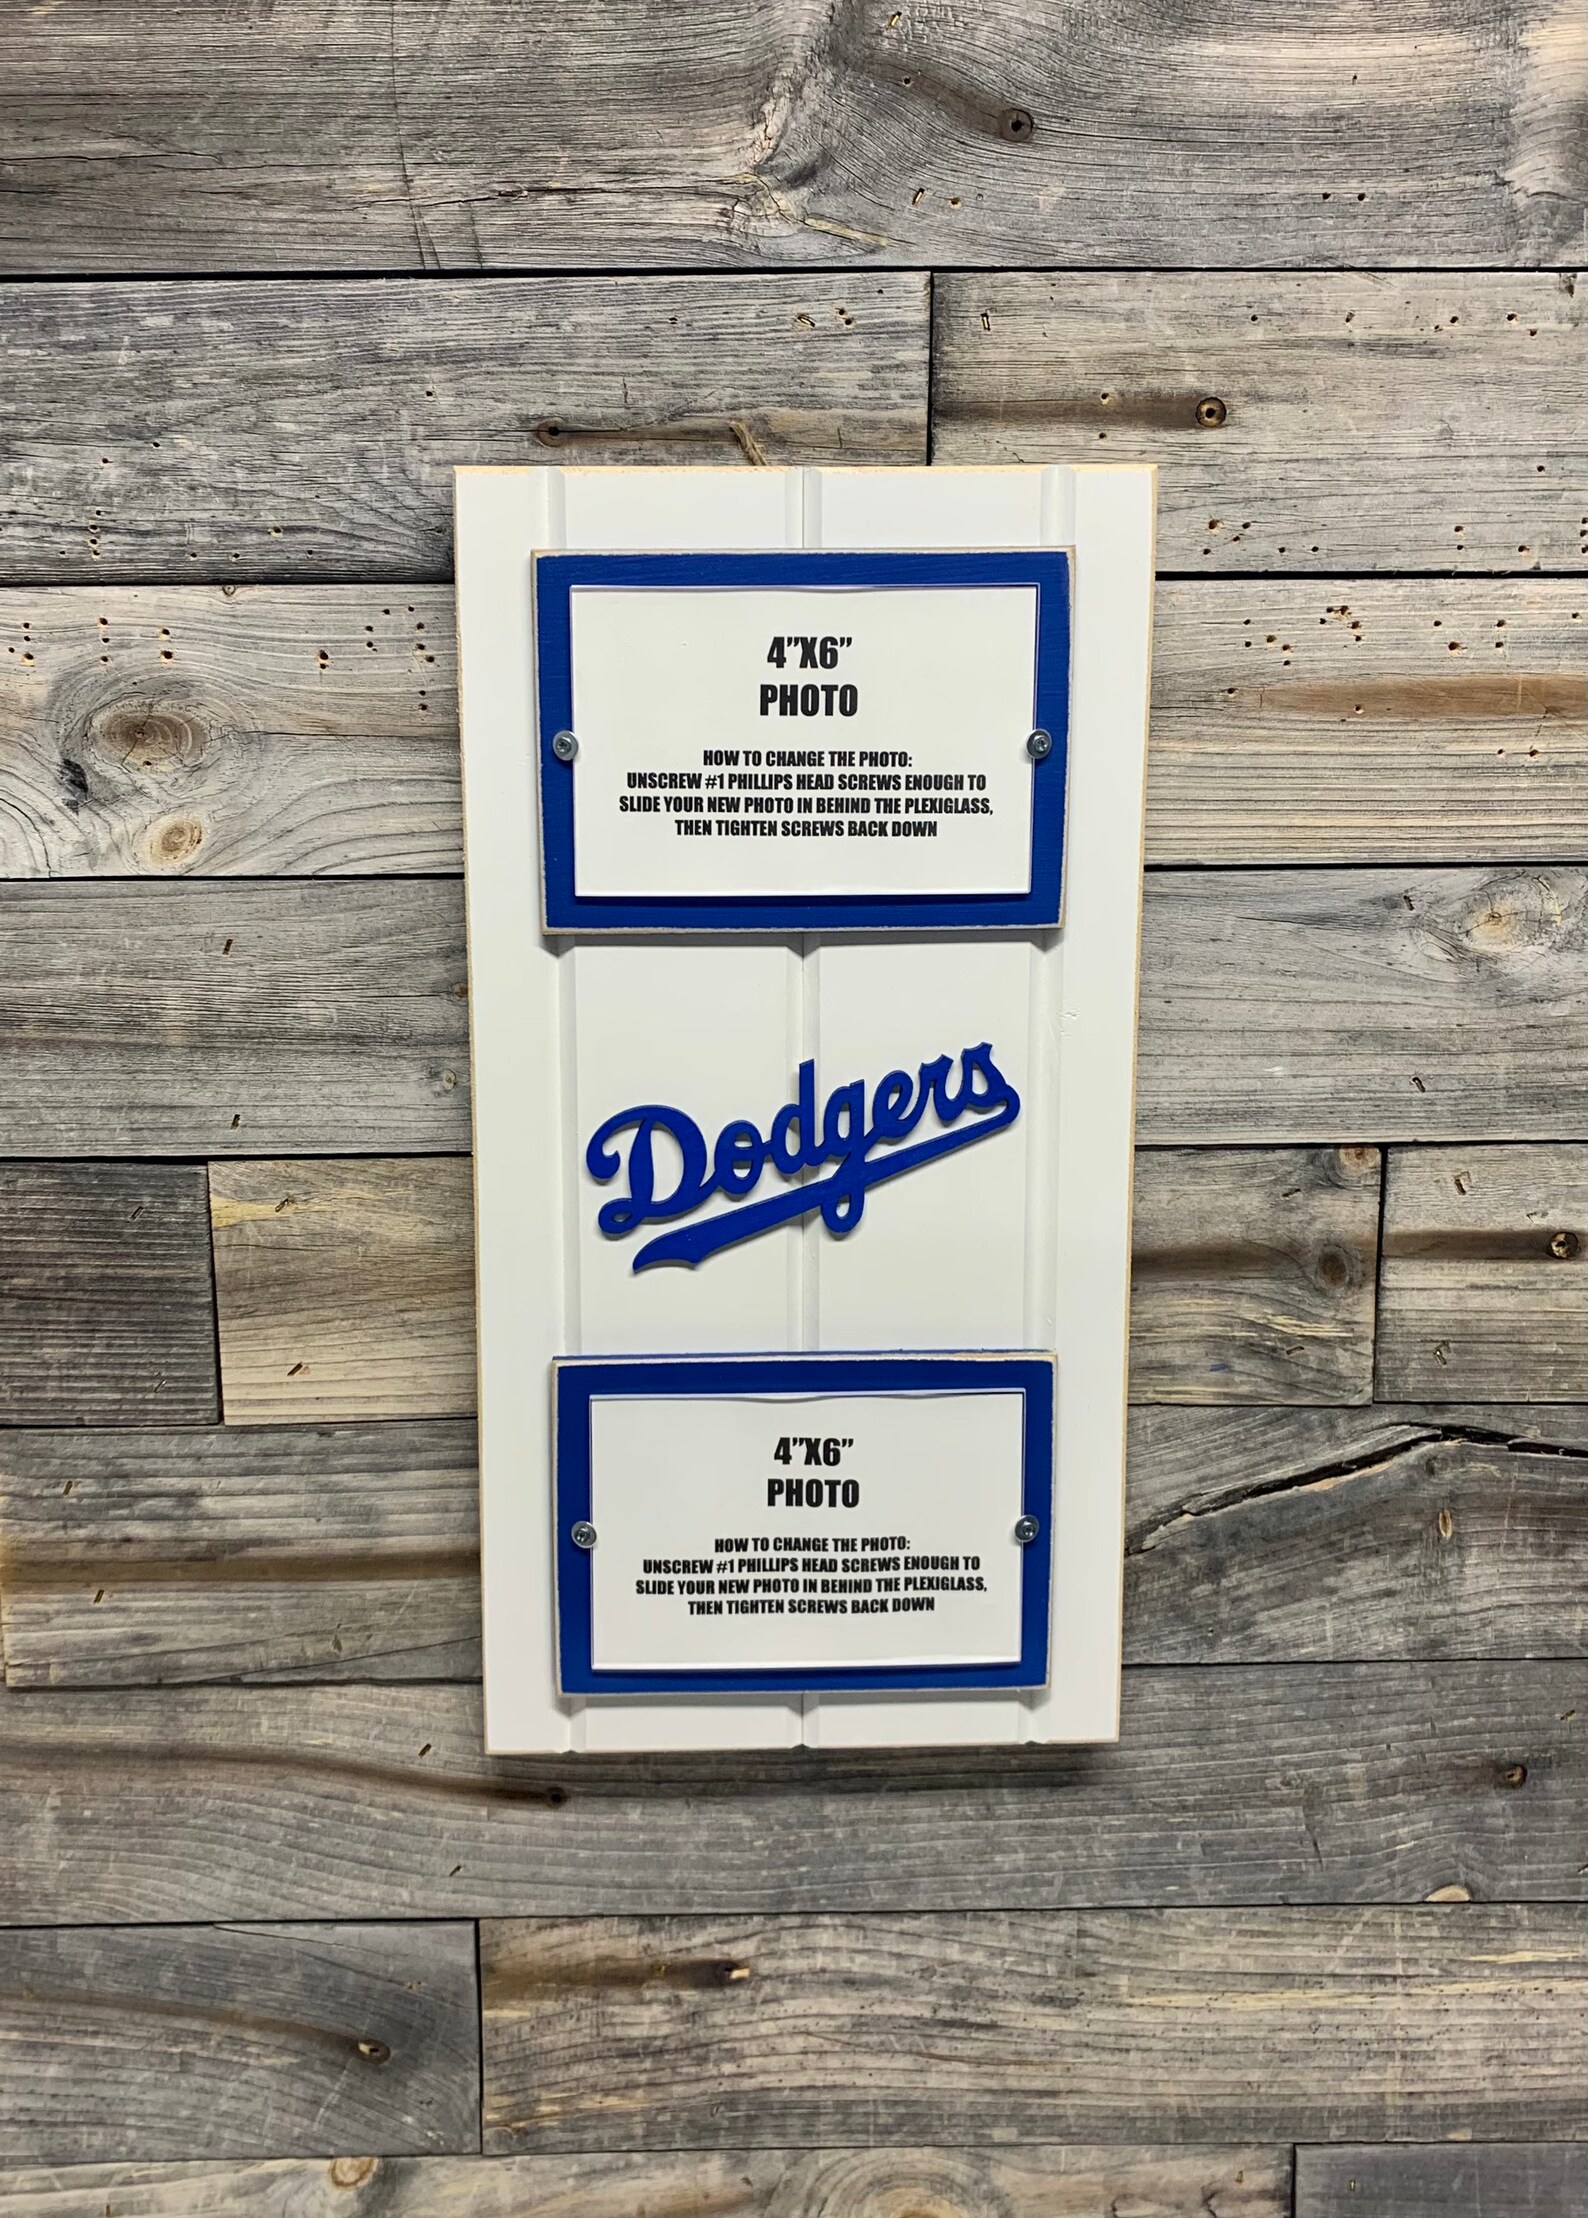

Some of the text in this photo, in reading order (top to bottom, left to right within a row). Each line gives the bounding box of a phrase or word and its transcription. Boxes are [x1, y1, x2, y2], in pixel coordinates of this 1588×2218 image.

[759, 683, 859, 717] PHOTO
[703, 749, 913, 768] HOW TO CHANGE THE PHOTO:
[626, 771, 987, 791] UNSCREW #1 PHILLIPS HEAD SCREWS ENOUGH TO
[619, 795, 994, 816] SLIDE YOUR NEW PHOTO IN BEHIND THE PLEXIGLASS,
[674, 819, 938, 838] THEN TIGHTEN SCREWS BACK DOWN
[587, 1042, 1021, 1273] Dodgers
[767, 1478, 860, 1509] PHOTO
[714, 1535, 911, 1554] HOW TO CHANGE THE PHOTO:
[642, 1555, 981, 1575] UNSCREW #1 PHILLIPS HEAD SCREWS ENOUGH TO
[635, 1575, 988, 1596] SLIDE YOUR NEW PHOTO IN BEHIND THE PLEXIGLASS,
[687, 1596, 935, 1616] THEN TIGHTEN SCREWS BACK DOWN
